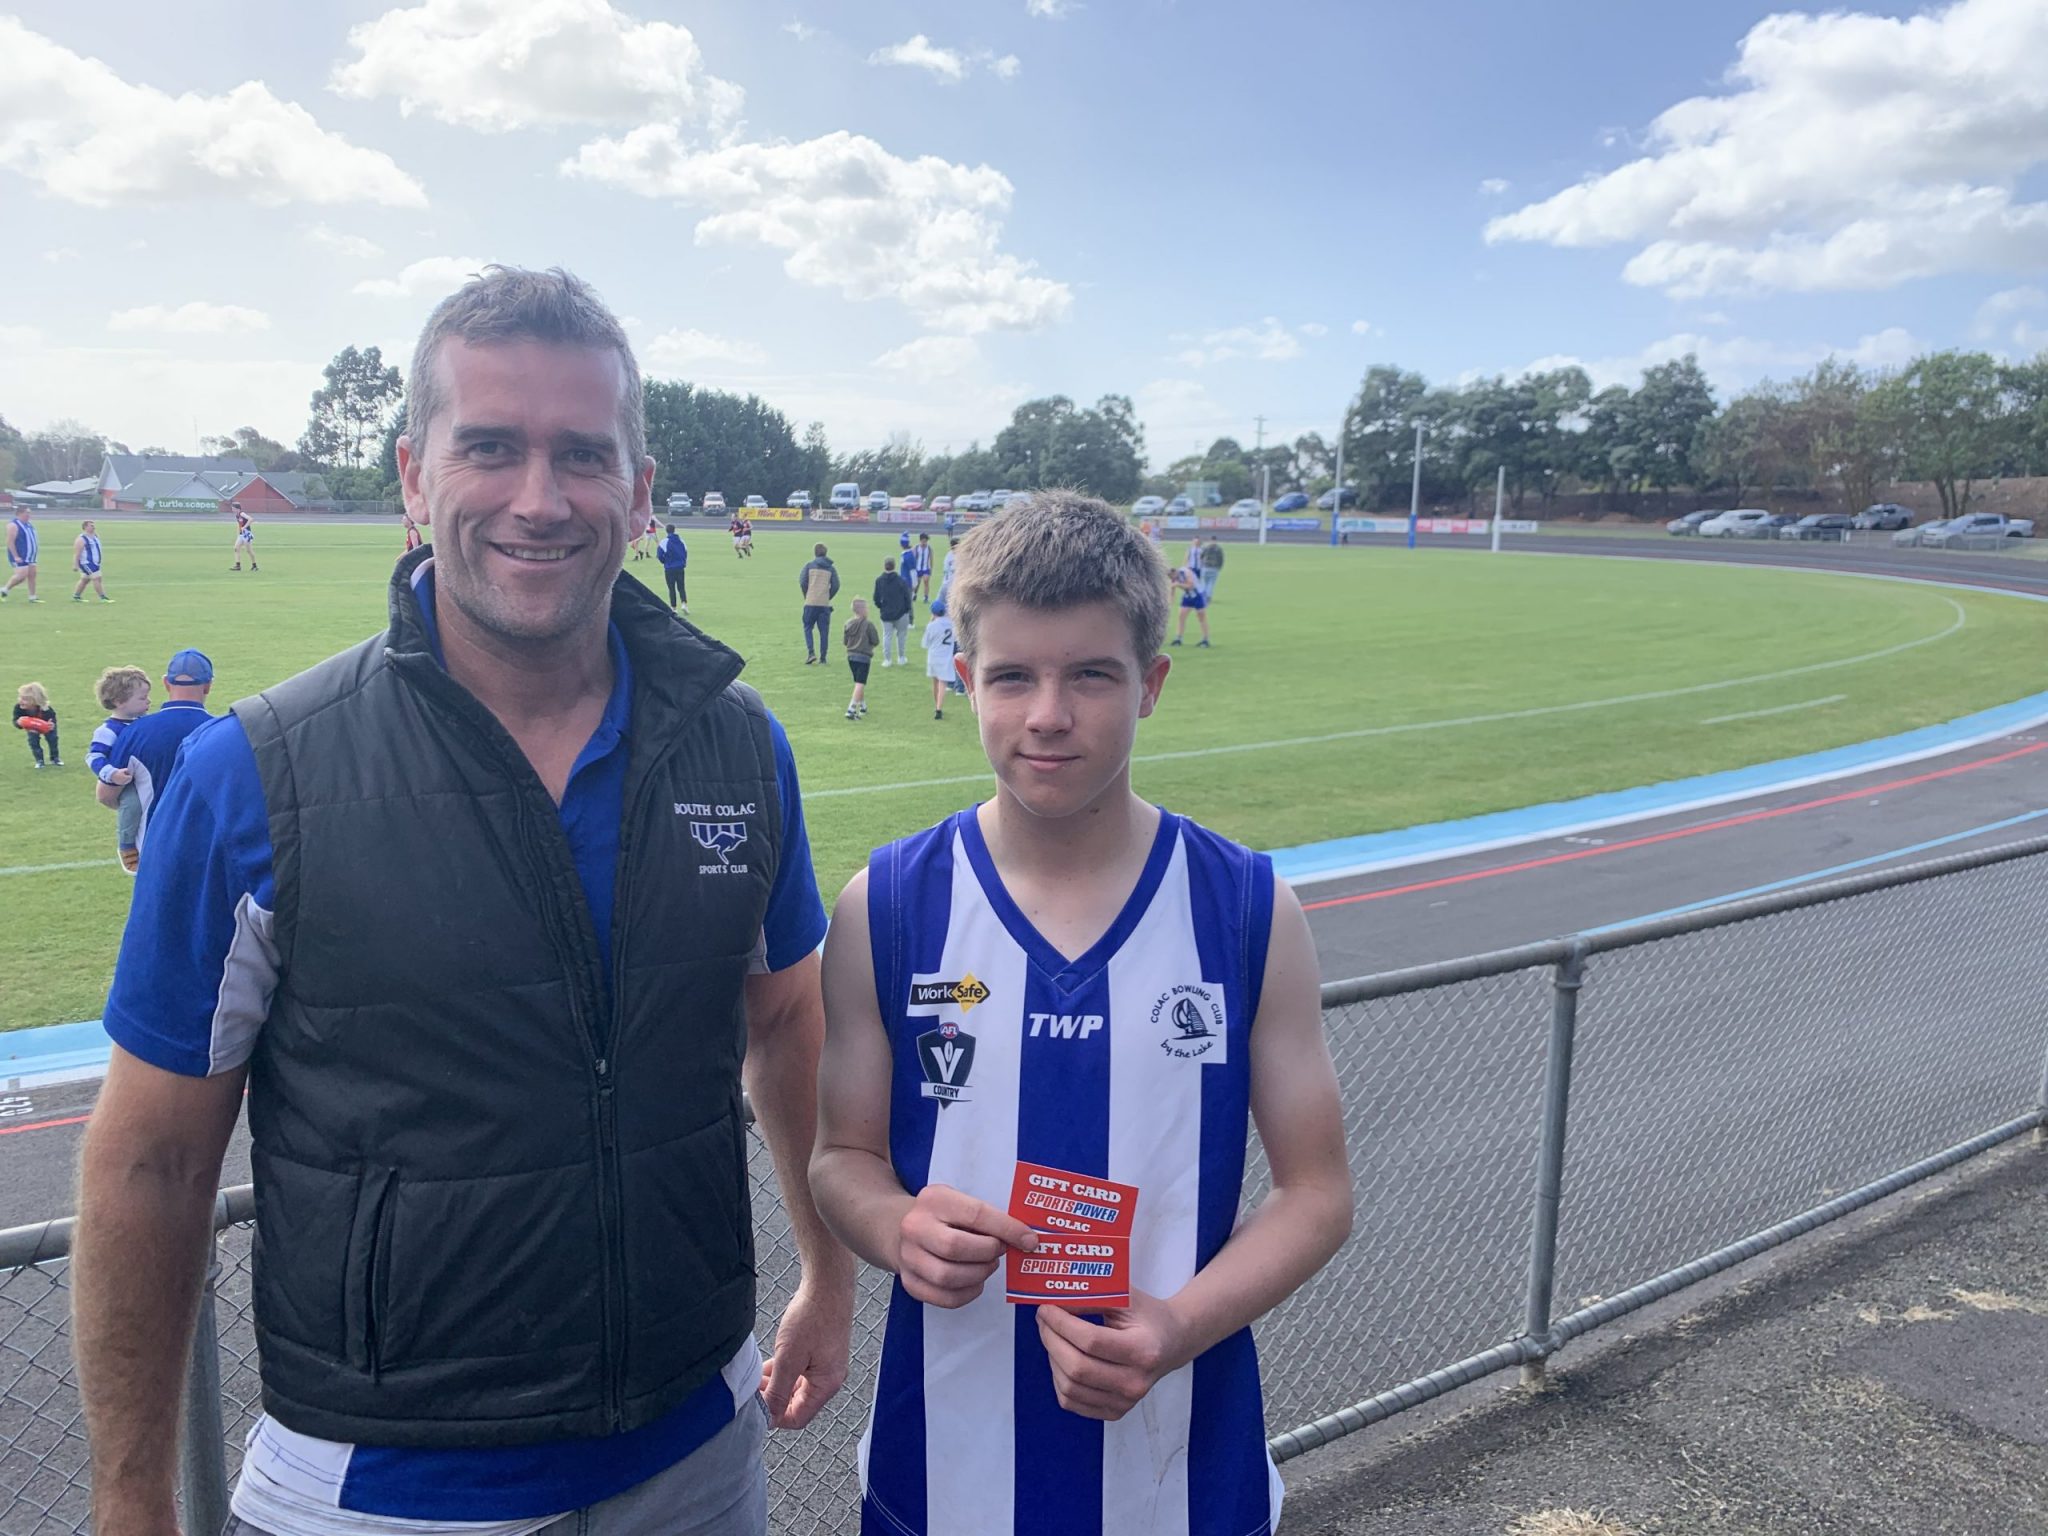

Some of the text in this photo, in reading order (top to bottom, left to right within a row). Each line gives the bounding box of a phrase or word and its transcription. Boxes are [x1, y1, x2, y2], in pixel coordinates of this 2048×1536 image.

[942, 628, 952, 645] 2
[674, 802, 756, 816] SOUTH COLAC
[698, 864, 748, 874] SPORTS CLUB
[1150, 984, 1224, 1025] COLAC BOWLING CLUB
[941, 1025, 958, 1036] AFL
[1028, 1013, 1104, 1039] TWP
[1160, 1038, 1214, 1058] by the Lake
[933, 1084, 960, 1099] COUNTRY
[1028, 1174, 1122, 1203] GIFT CARD
[1025, 1192, 1119, 1223] SPORTSPOWER
[1046, 1216, 1091, 1233] COLAC
[1023, 1243, 1114, 1257] FT CARD
[1021, 1259, 1114, 1277] SPORTSPOWER
[1045, 1280, 1090, 1291] COLAC
